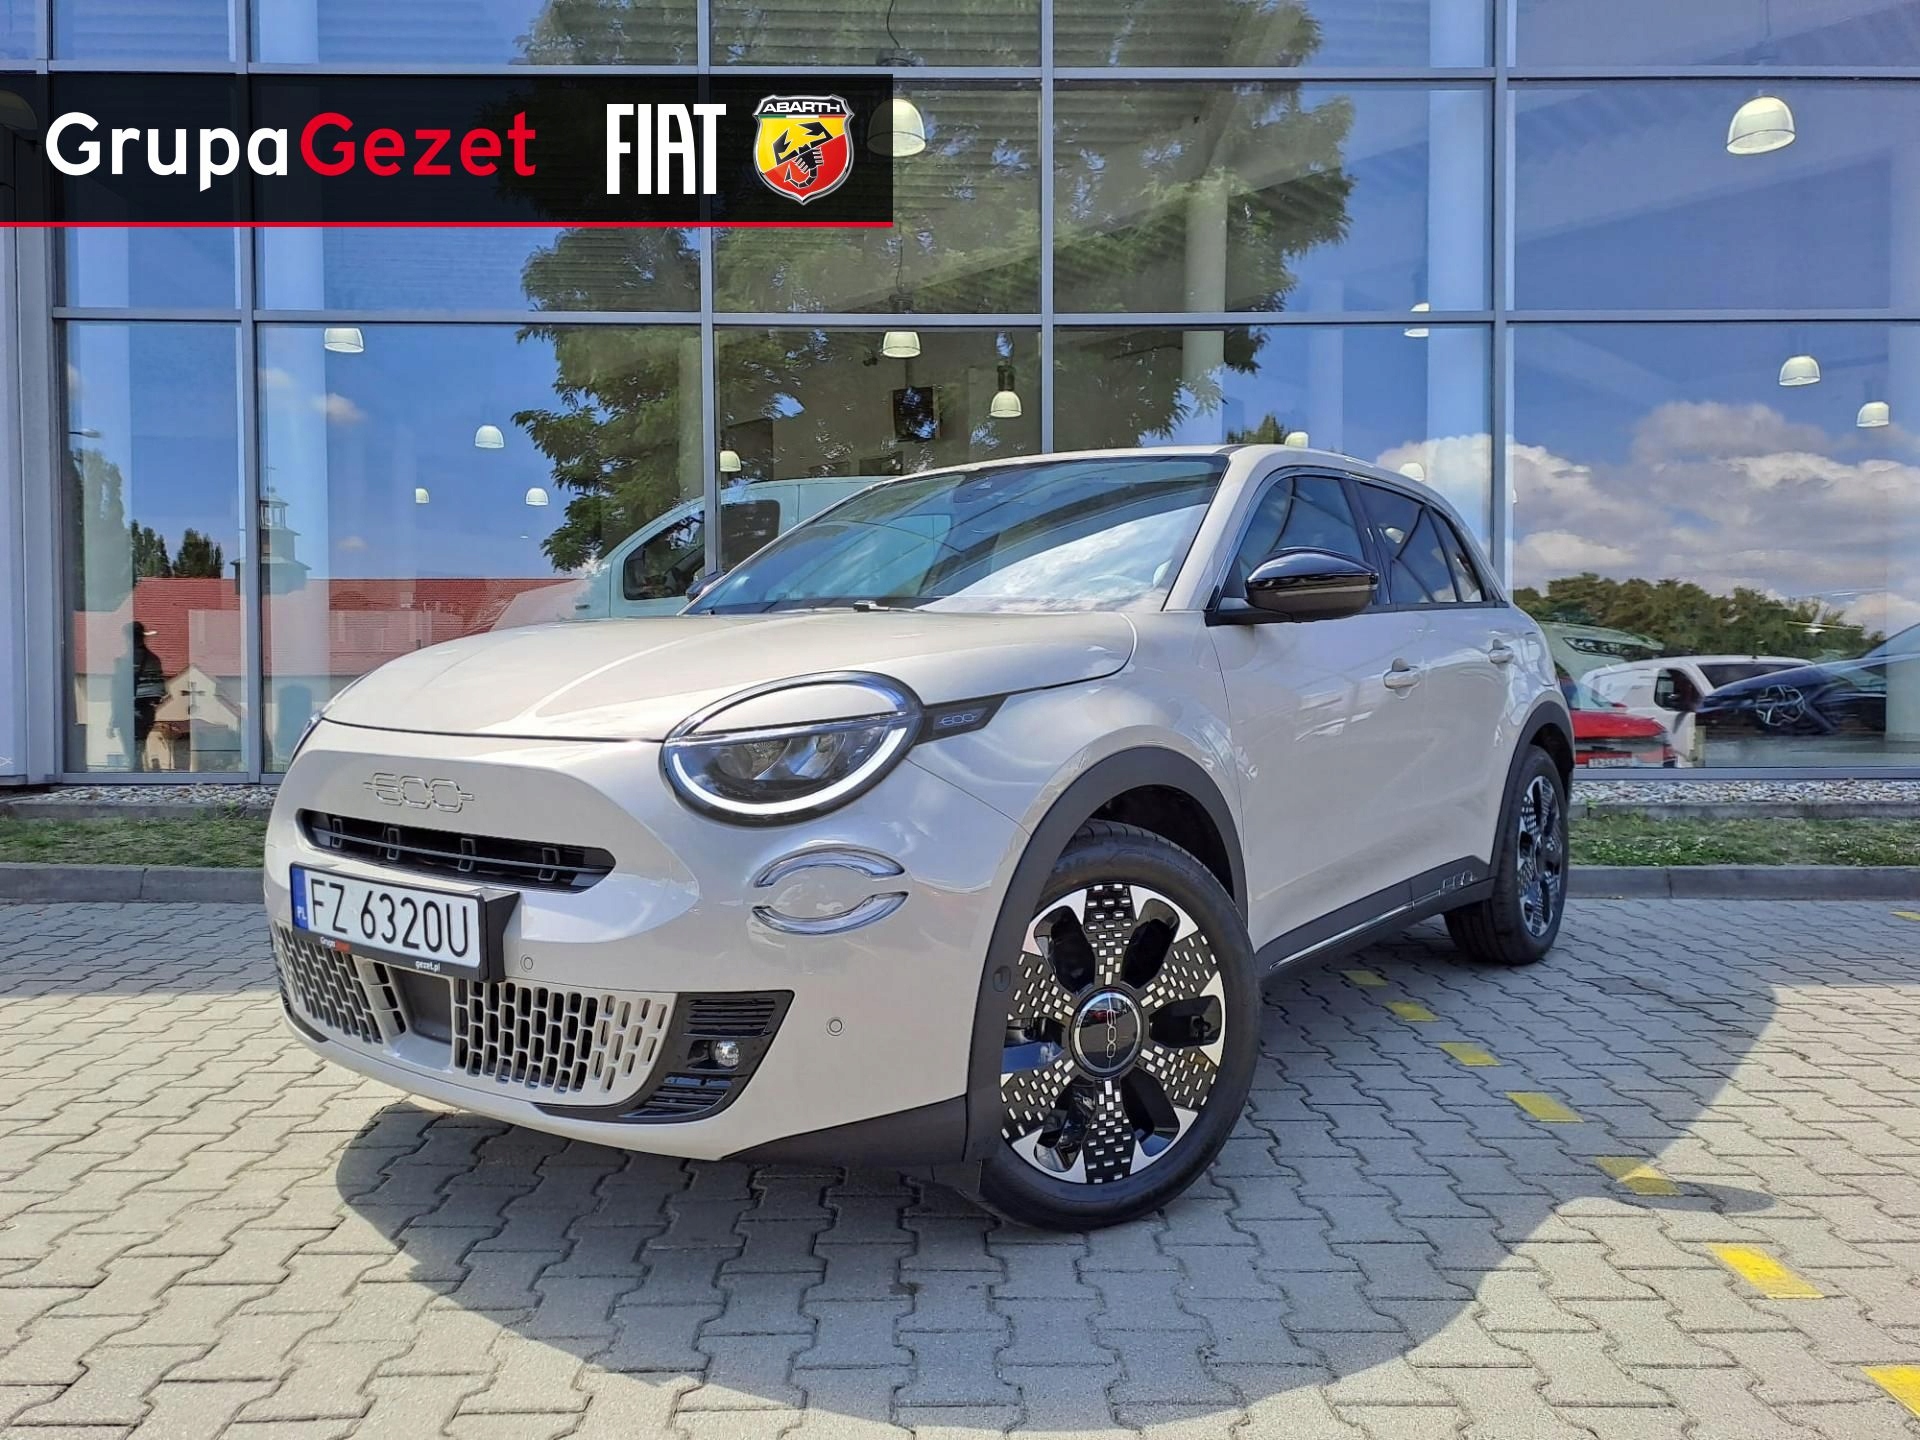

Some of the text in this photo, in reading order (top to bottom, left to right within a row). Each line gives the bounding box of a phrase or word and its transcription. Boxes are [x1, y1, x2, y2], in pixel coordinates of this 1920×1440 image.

[296, 905, 308, 920] PL
[310, 878, 469, 958] FZ 6320U
